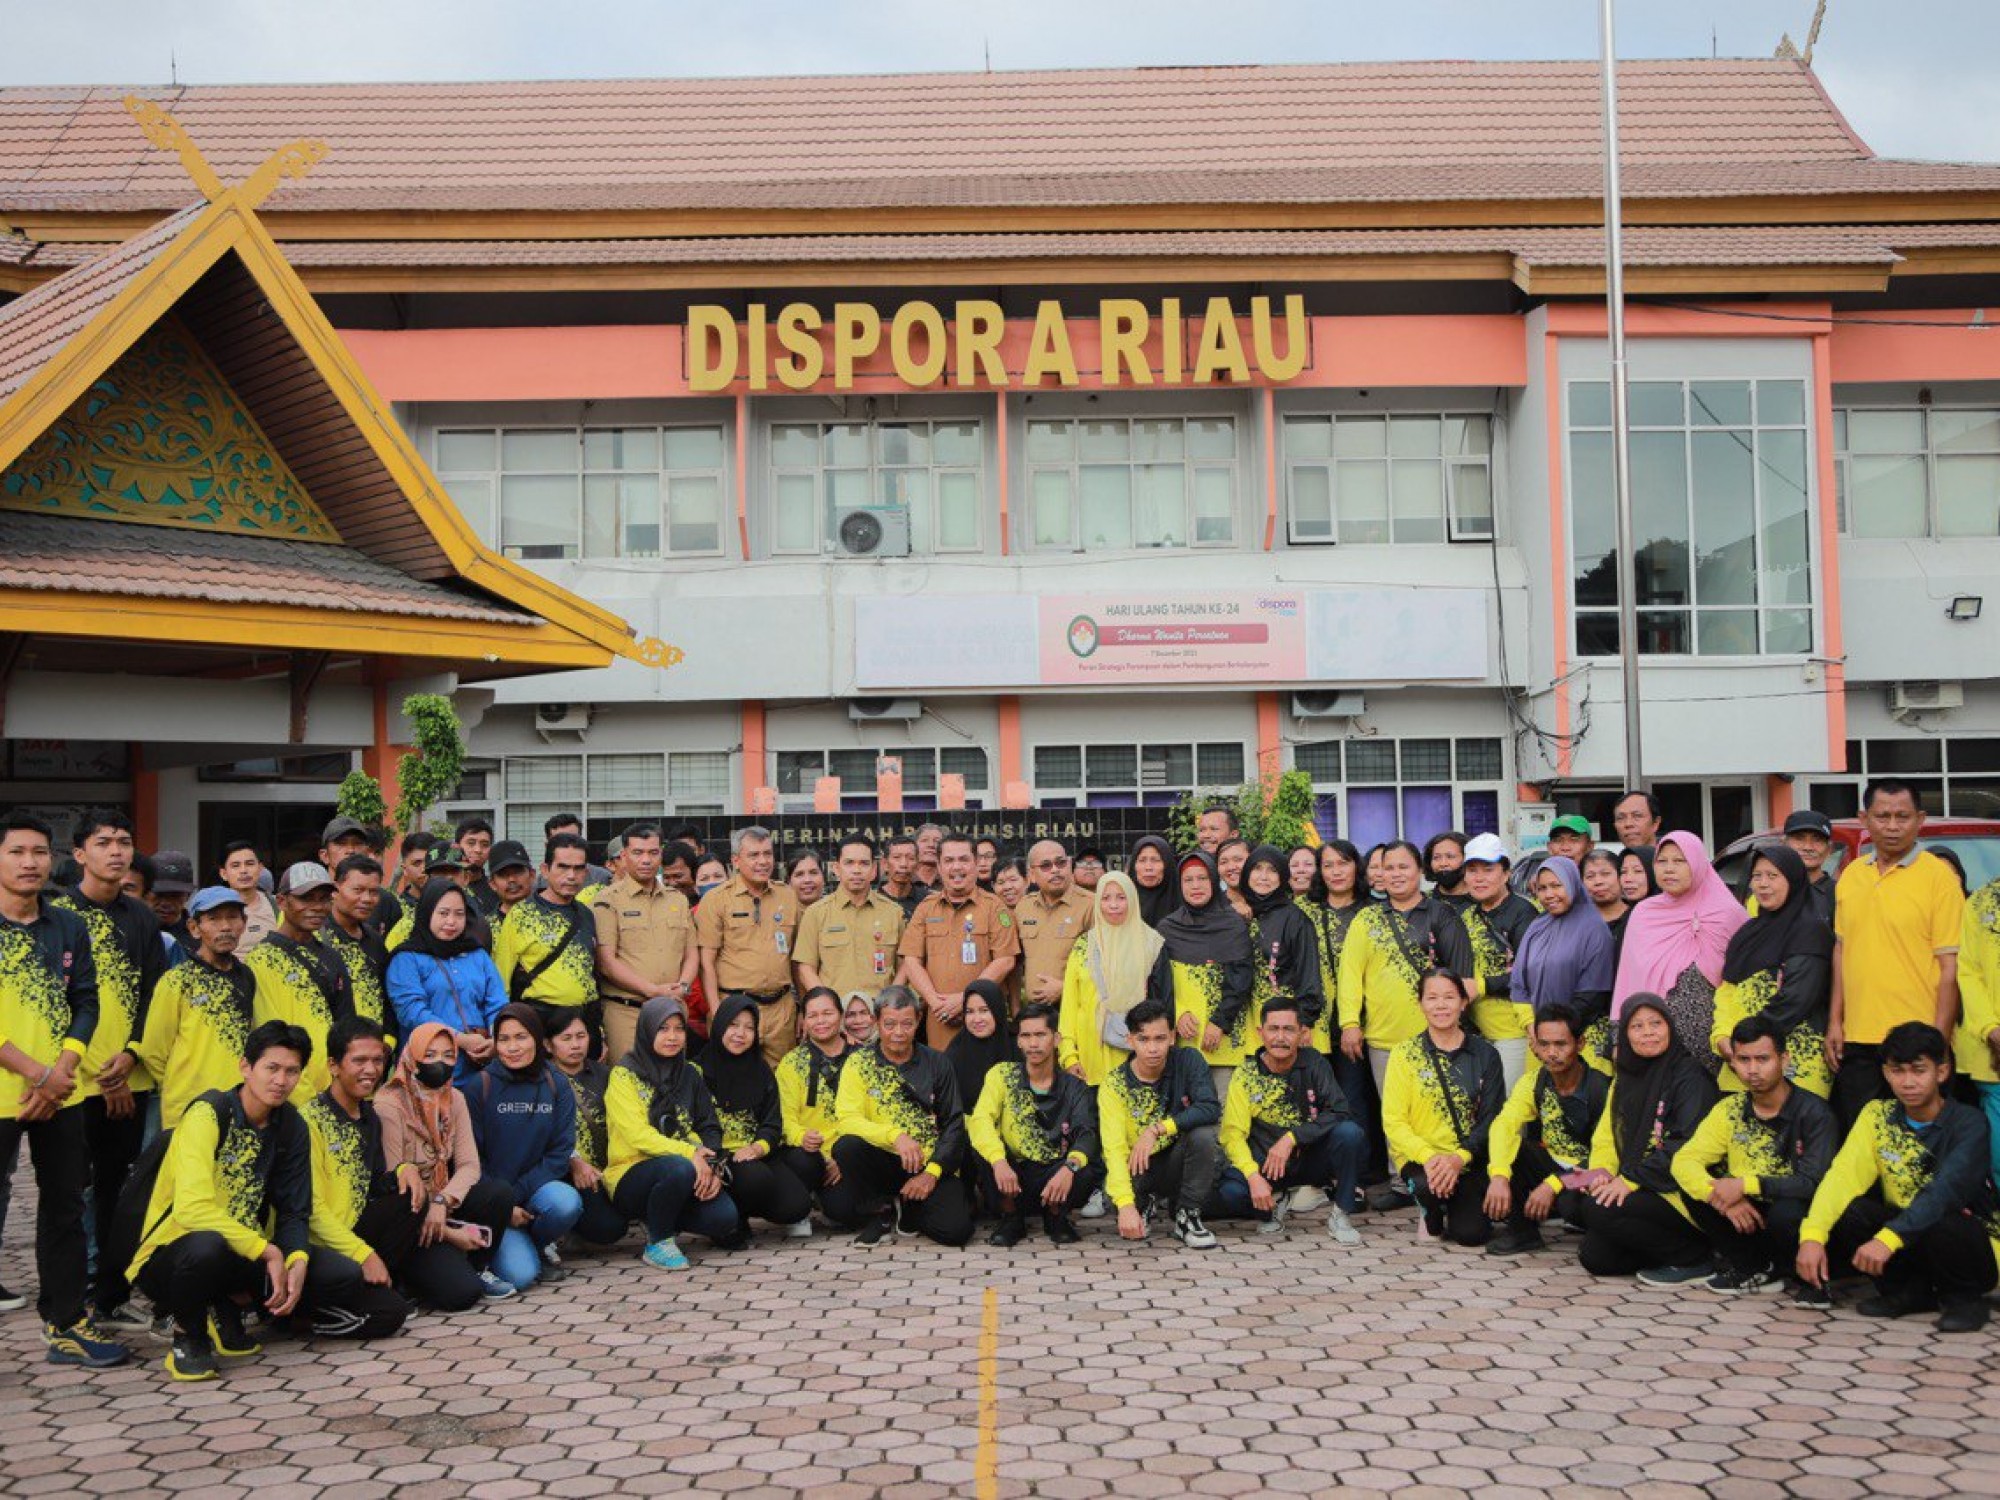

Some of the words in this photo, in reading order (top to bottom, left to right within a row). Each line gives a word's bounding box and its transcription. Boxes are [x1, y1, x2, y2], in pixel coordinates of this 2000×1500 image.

[688, 300, 1080, 391] DISPORA
[1101, 294, 1307, 384] RIAU
[1106, 604, 1131, 616] HARI
[1133, 603, 1168, 616] ULANG
[1172, 603, 1207, 615] TAHUN
[1259, 598, 1296, 610] dispora
[769, 826, 894, 845] MERINTAH
[1035, 822, 1094, 838] RIAU
